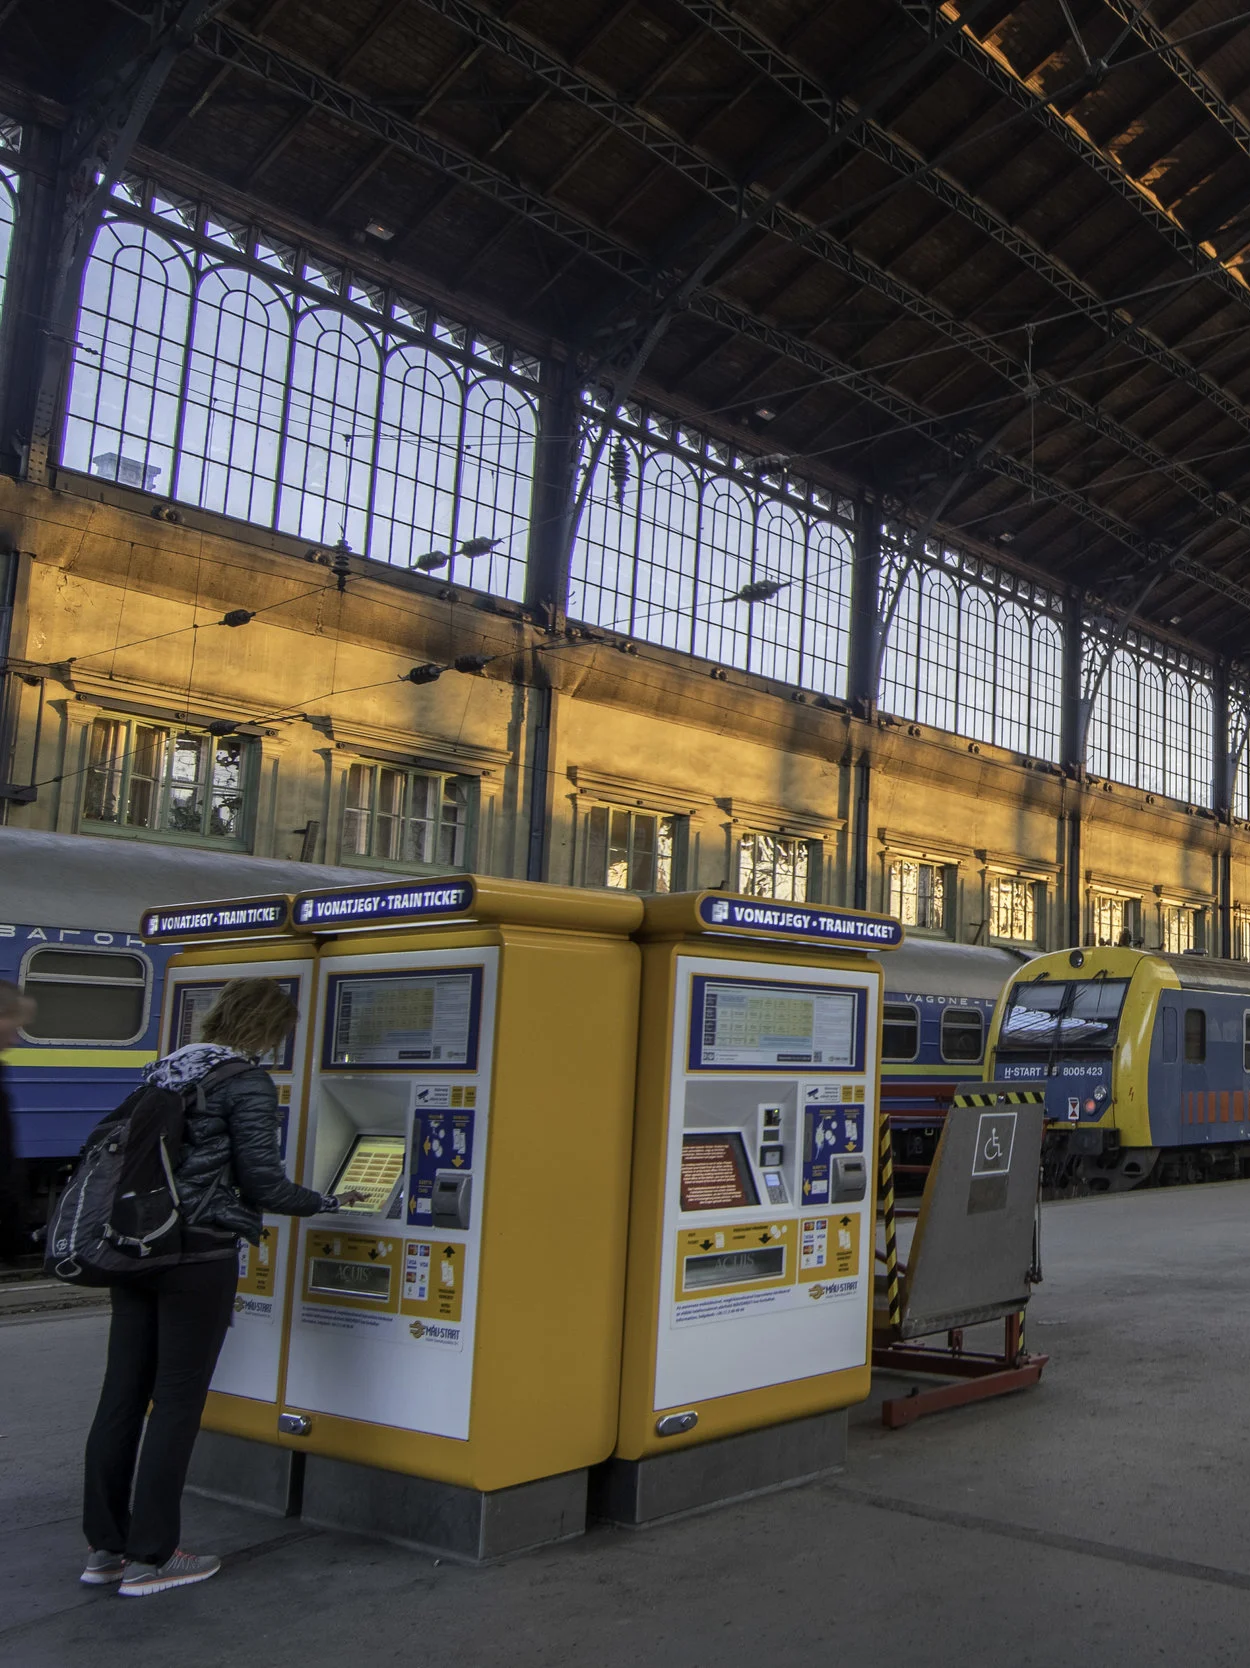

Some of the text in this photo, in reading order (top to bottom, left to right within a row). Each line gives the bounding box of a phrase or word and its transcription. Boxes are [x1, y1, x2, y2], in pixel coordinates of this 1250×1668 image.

[317, 888, 465, 917] VONATJEGY TRAIN TICKET
[161, 906, 281, 931] VONATJEGY TRAIN TICKET
[734, 906, 895, 939] VONATJEGY TRAIN TICKET
[905, 993, 968, 1006] VAGONE
[1004, 1066, 1041, 1078] H-START
[1063, 1066, 1085, 1076] 8005
[1086, 1066, 1103, 1076] 423
